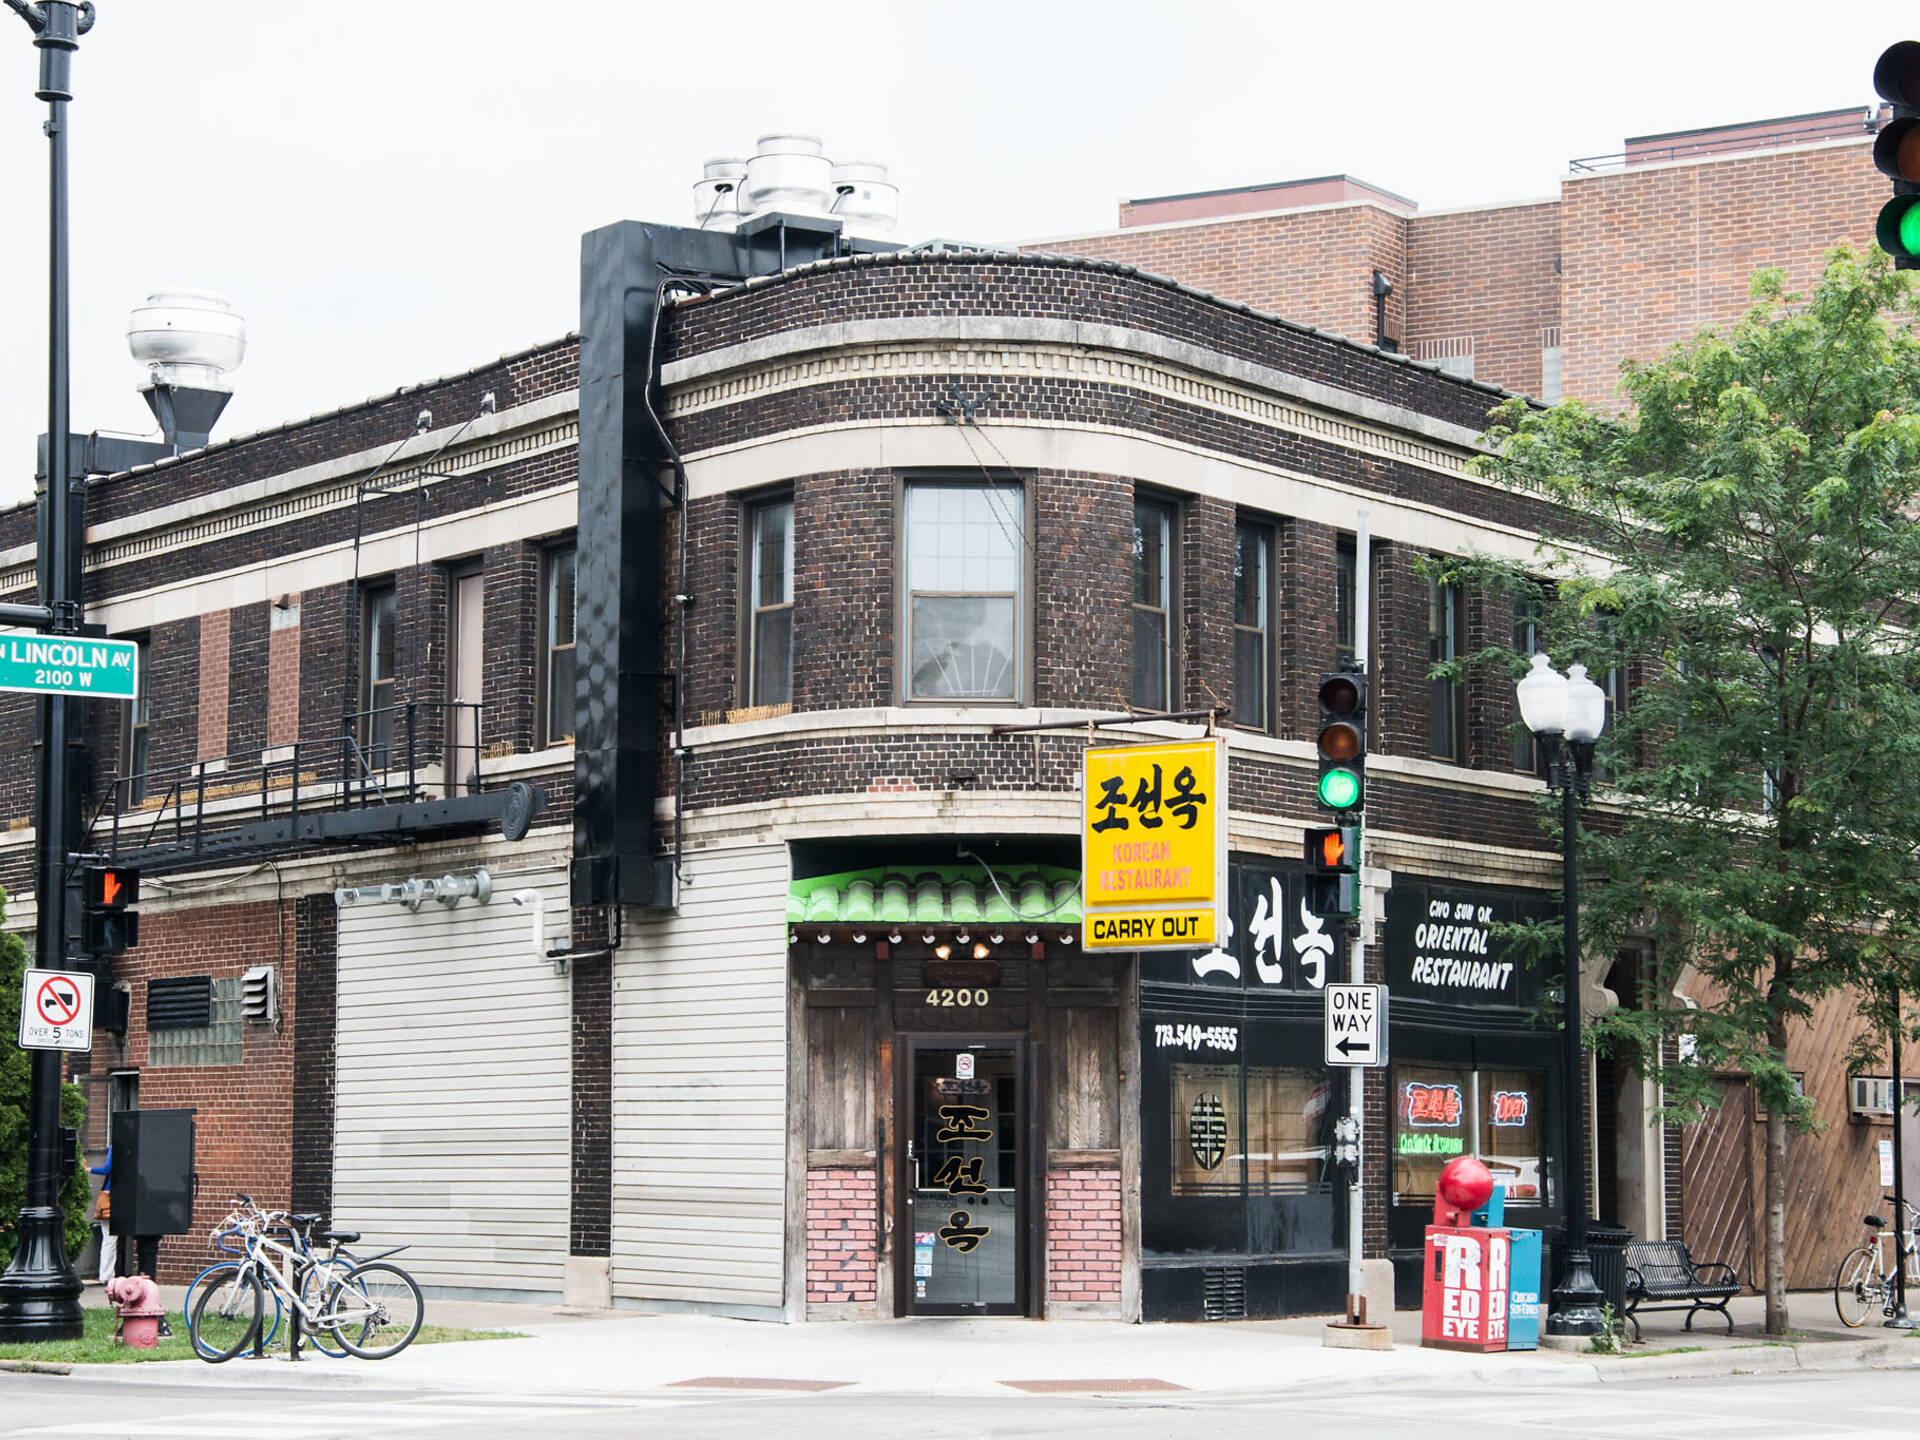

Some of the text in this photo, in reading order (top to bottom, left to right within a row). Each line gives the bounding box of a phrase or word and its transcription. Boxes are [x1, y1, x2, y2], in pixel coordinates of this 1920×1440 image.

[11, 641, 108, 668] LINCOLN
[111, 652, 131, 668] AV
[34, 669, 92, 687] 2100 W
[1091, 763, 1207, 833] 조선옥
[1112, 841, 1171, 863] KOREAN
[1099, 867, 1191, 891] RESTAURANT
[1429, 899, 1493, 923] CHO SUN OK
[1093, 916, 1199, 940] CARRY OUT
[1415, 923, 1488, 955] ORIENTAL
[1411, 956, 1513, 991] RESTAURANT
[925, 988, 989, 1007] 4200
[1333, 991, 1372, 1011] ONE
[28, 1026, 84, 1039] OVER 5 TONS
[1332, 1014, 1373, 1033] WAY
[1154, 1023, 1239, 1052] 773.549-5555
[1443, 1318, 1480, 1340] EYE
[1488, 1319, 1505, 1340] EYE
